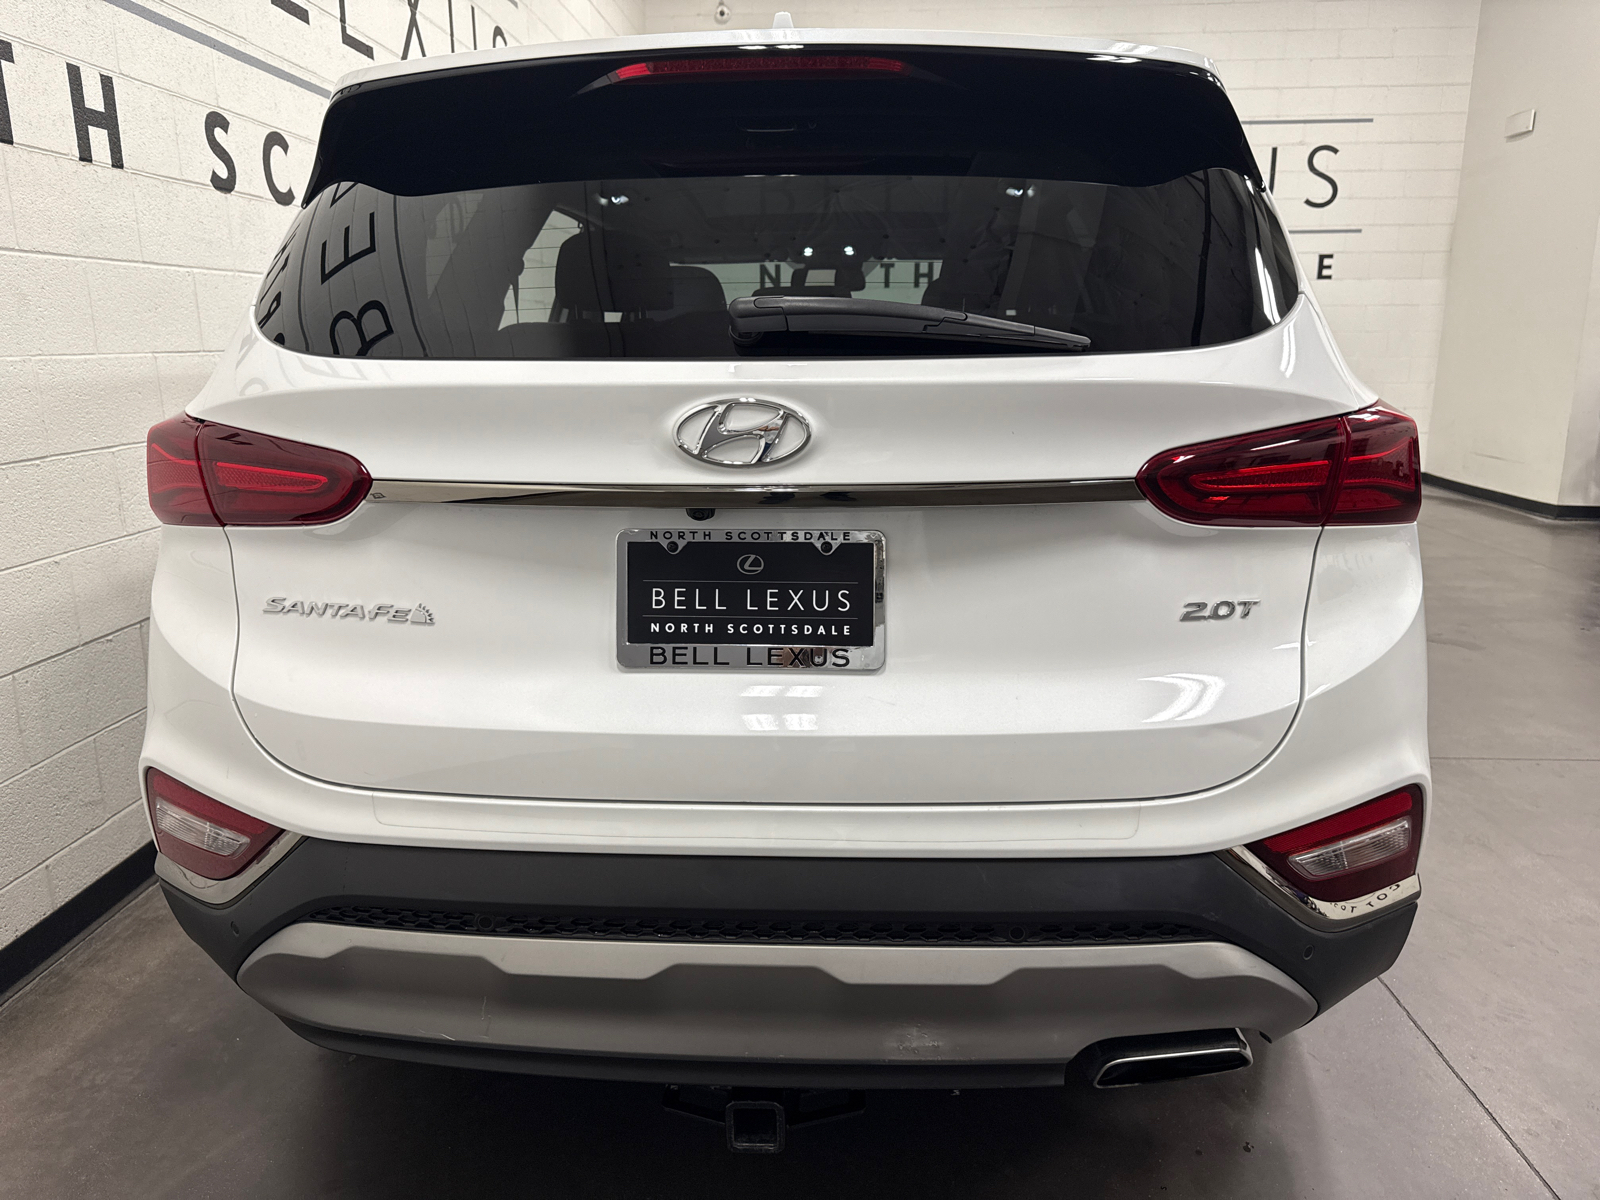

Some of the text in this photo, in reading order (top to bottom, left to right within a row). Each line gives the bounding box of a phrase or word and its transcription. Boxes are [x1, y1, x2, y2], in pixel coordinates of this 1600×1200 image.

[650, 531, 851, 541] NORTH SCOTTSDALE
[652, 588, 851, 612] BELL LEXUS
[650, 622, 851, 636] NORTH SCOTTSDALE
[650, 646, 850, 668] BELL LEXUS
